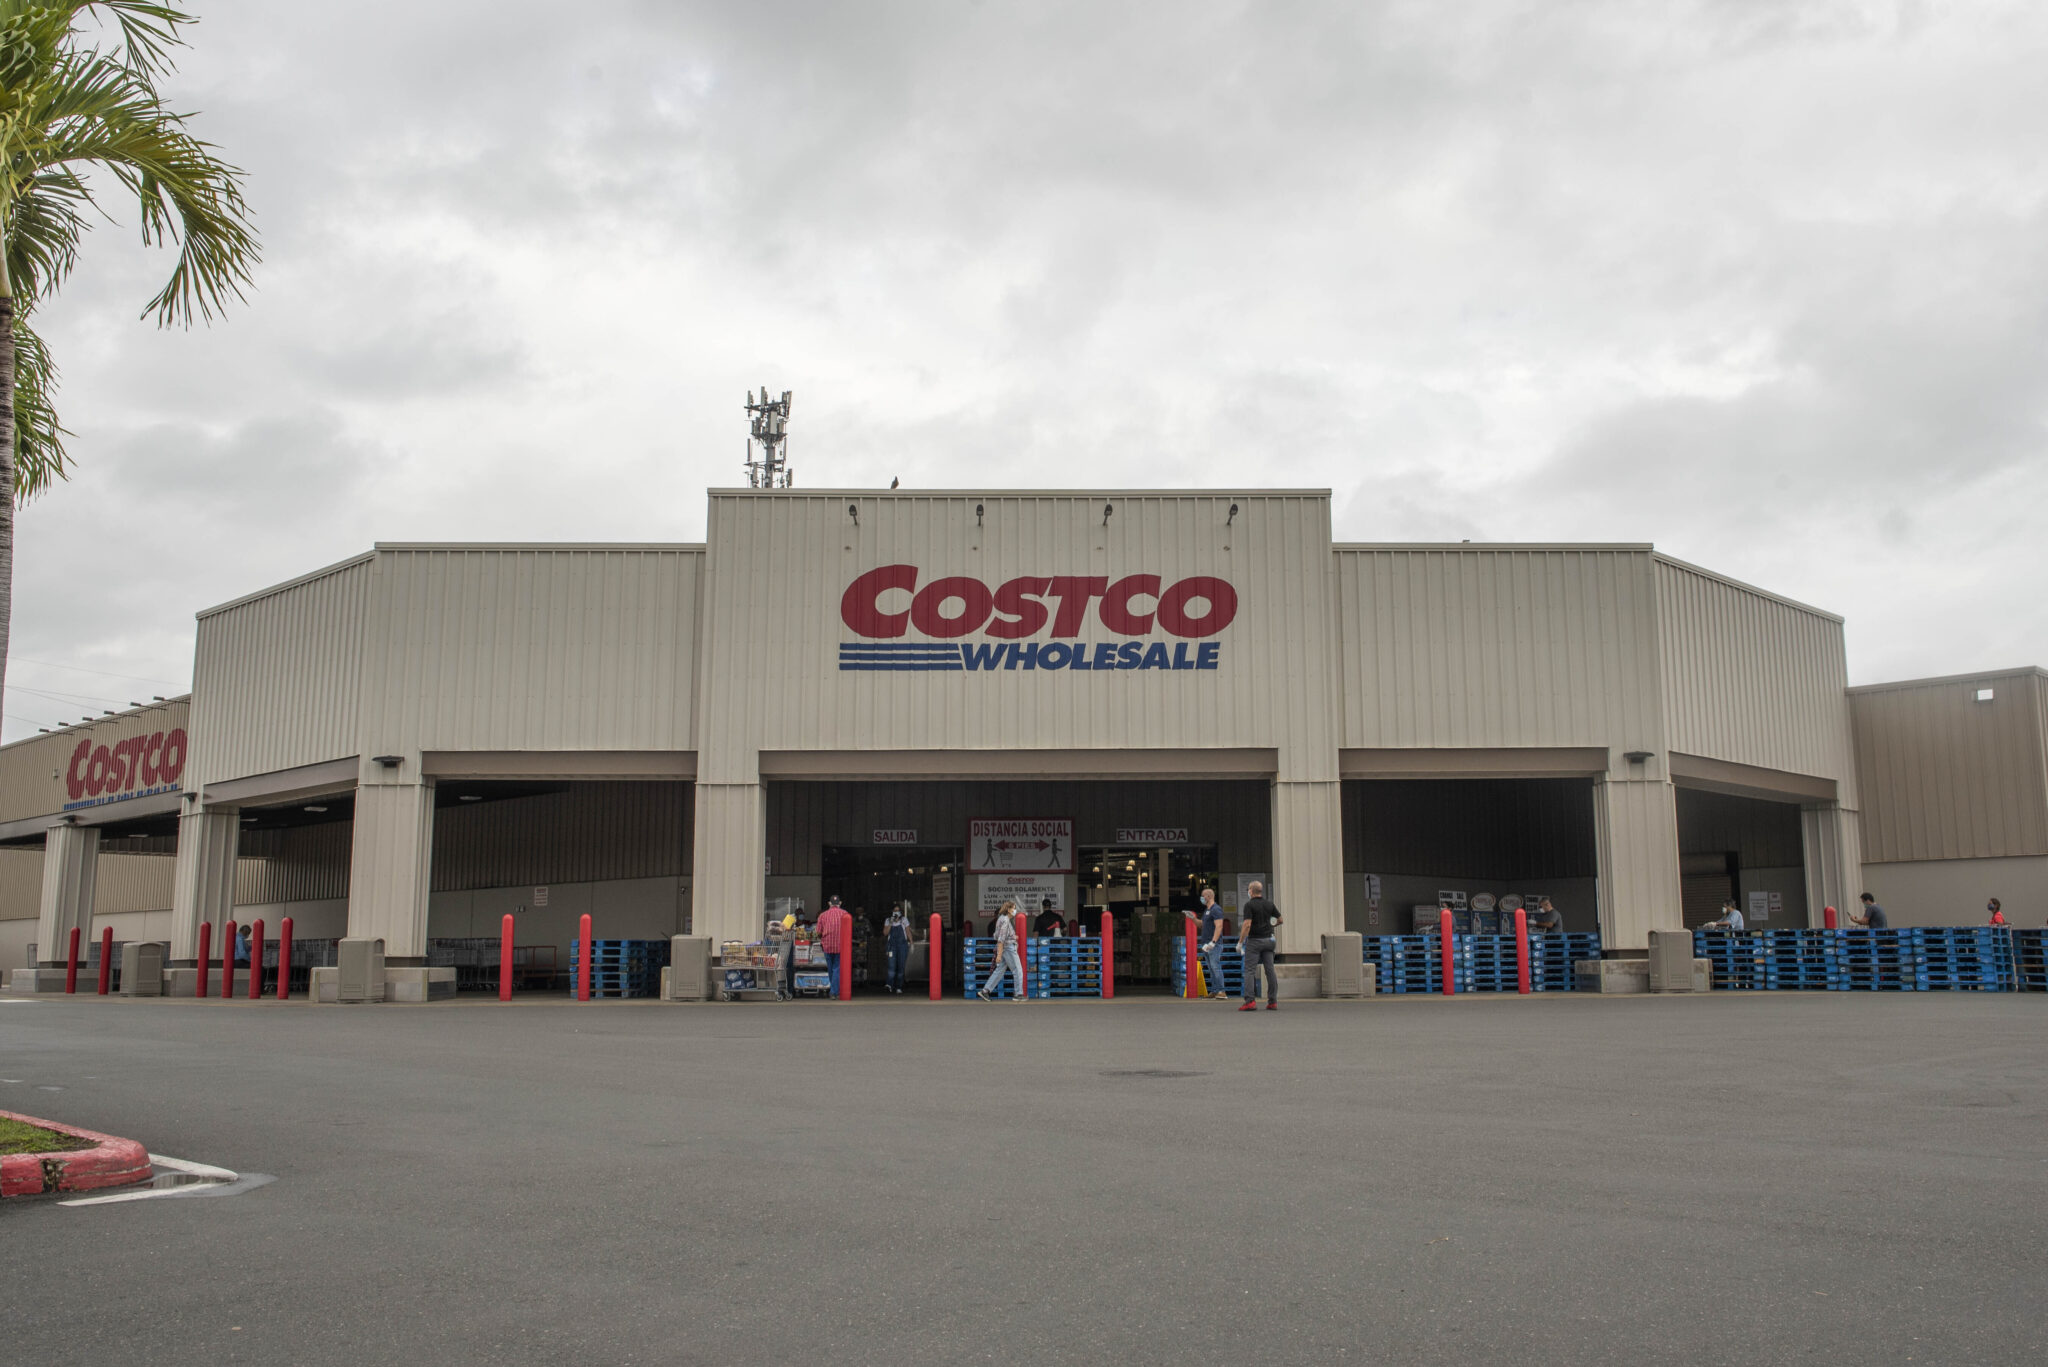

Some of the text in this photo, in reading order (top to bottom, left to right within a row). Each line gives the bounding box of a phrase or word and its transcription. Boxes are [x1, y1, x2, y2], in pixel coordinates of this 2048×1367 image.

[841, 564, 1238, 639] COSTCO
[959, 641, 1220, 671] WHOLESALE
[66, 728, 188, 801] COSTCO
[874, 831, 916, 842] SALIDA
[973, 822, 1069, 837] DISTANCIA SOCIAL
[1117, 830, 1187, 841] ENTRADA
